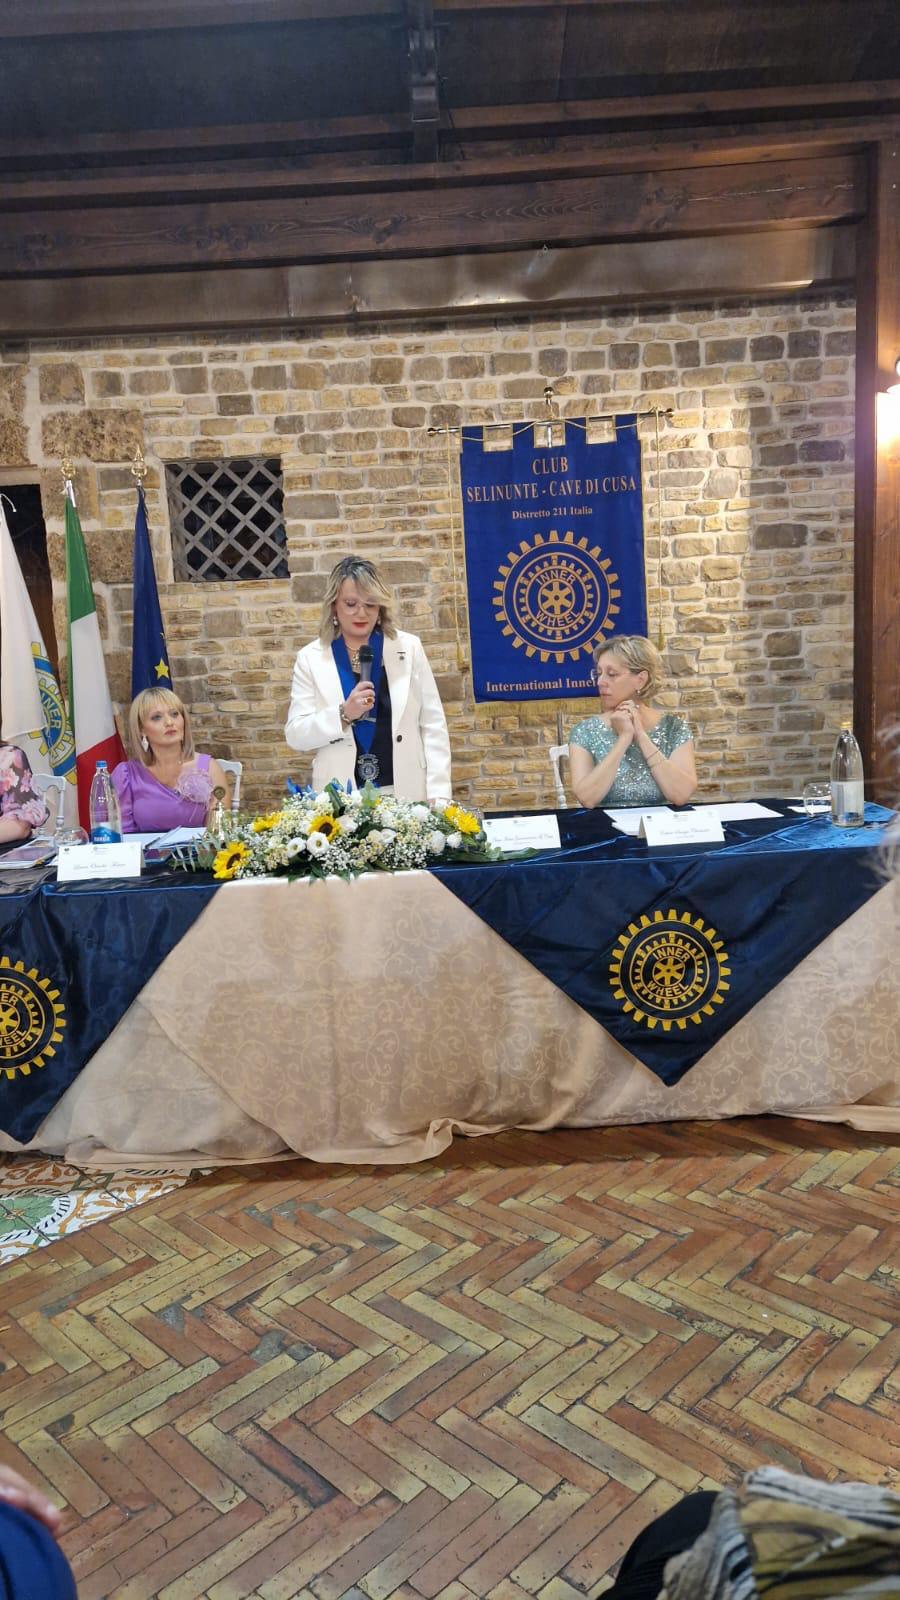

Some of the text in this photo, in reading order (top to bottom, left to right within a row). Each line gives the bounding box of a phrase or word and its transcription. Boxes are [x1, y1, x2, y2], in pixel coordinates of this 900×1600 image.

[532, 456, 569, 476] CLUB
[466, 482, 539, 503] SELINUNTE
[550, 479, 582, 497] CAVE
[586, 478, 599, 494] DI
[602, 475, 637, 493] CUSA
[512, 506, 593, 520] Distretto 211 Italia
[535, 569, 577, 586] INNER
[536, 609, 581, 627] WHEEL
[486, 678, 563, 692] International
[652, 946, 691, 962] INNER
[646, 980, 689, 997] WHEEL
[0, 1030, 27, 1045] EEL
